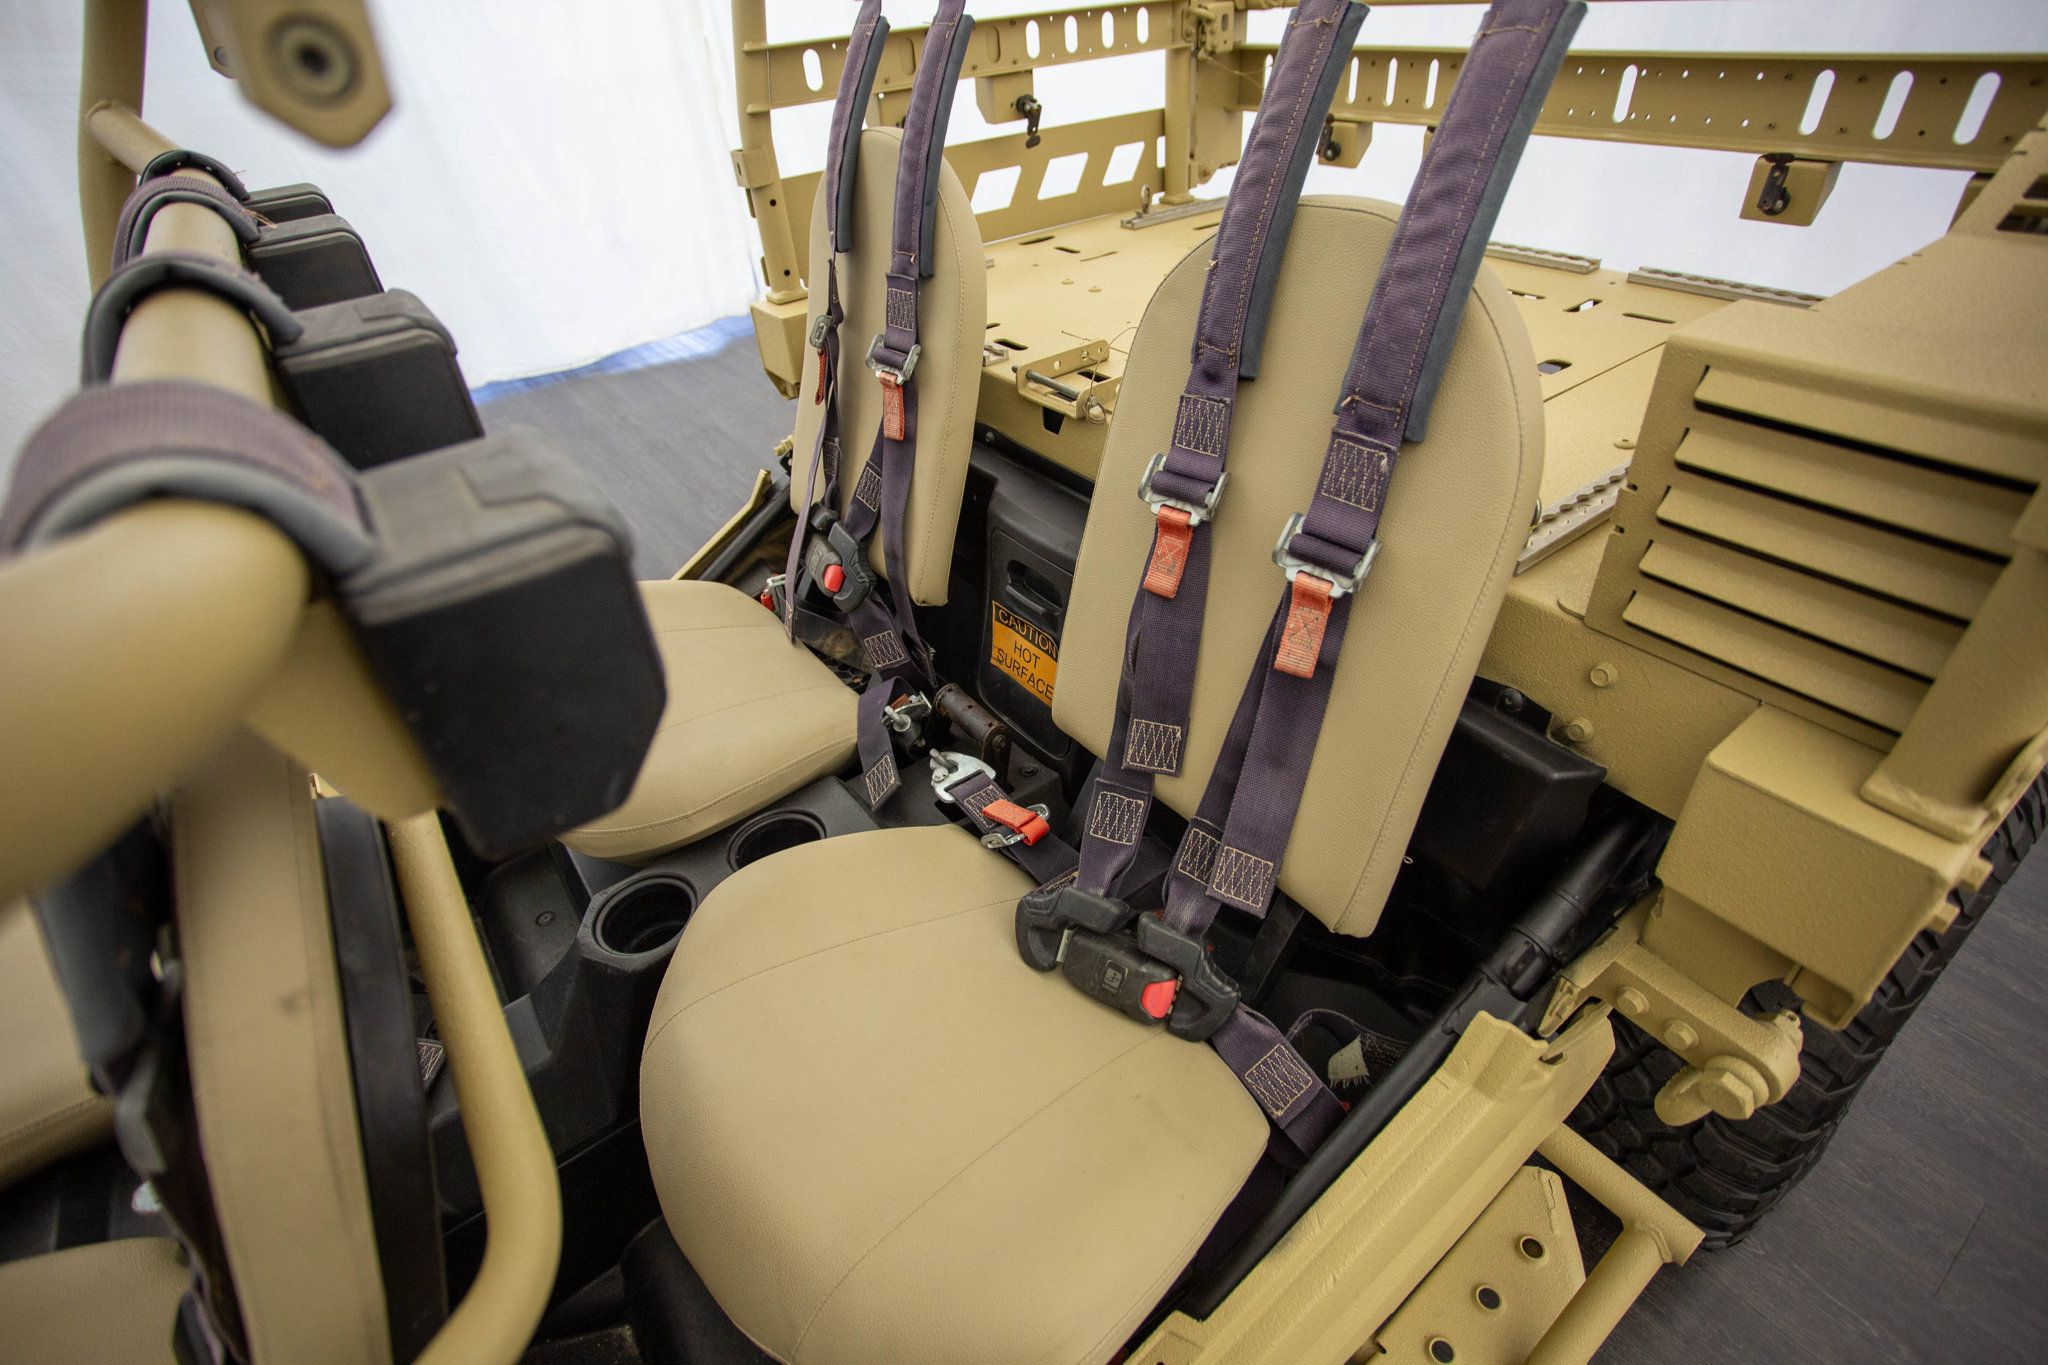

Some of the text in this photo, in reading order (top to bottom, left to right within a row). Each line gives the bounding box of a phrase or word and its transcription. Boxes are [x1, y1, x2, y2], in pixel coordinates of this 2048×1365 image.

[998, 609, 1057, 659] CAUTION
[1013, 641, 1040, 669] HOT
[996, 648, 1054, 700] SURFACE
